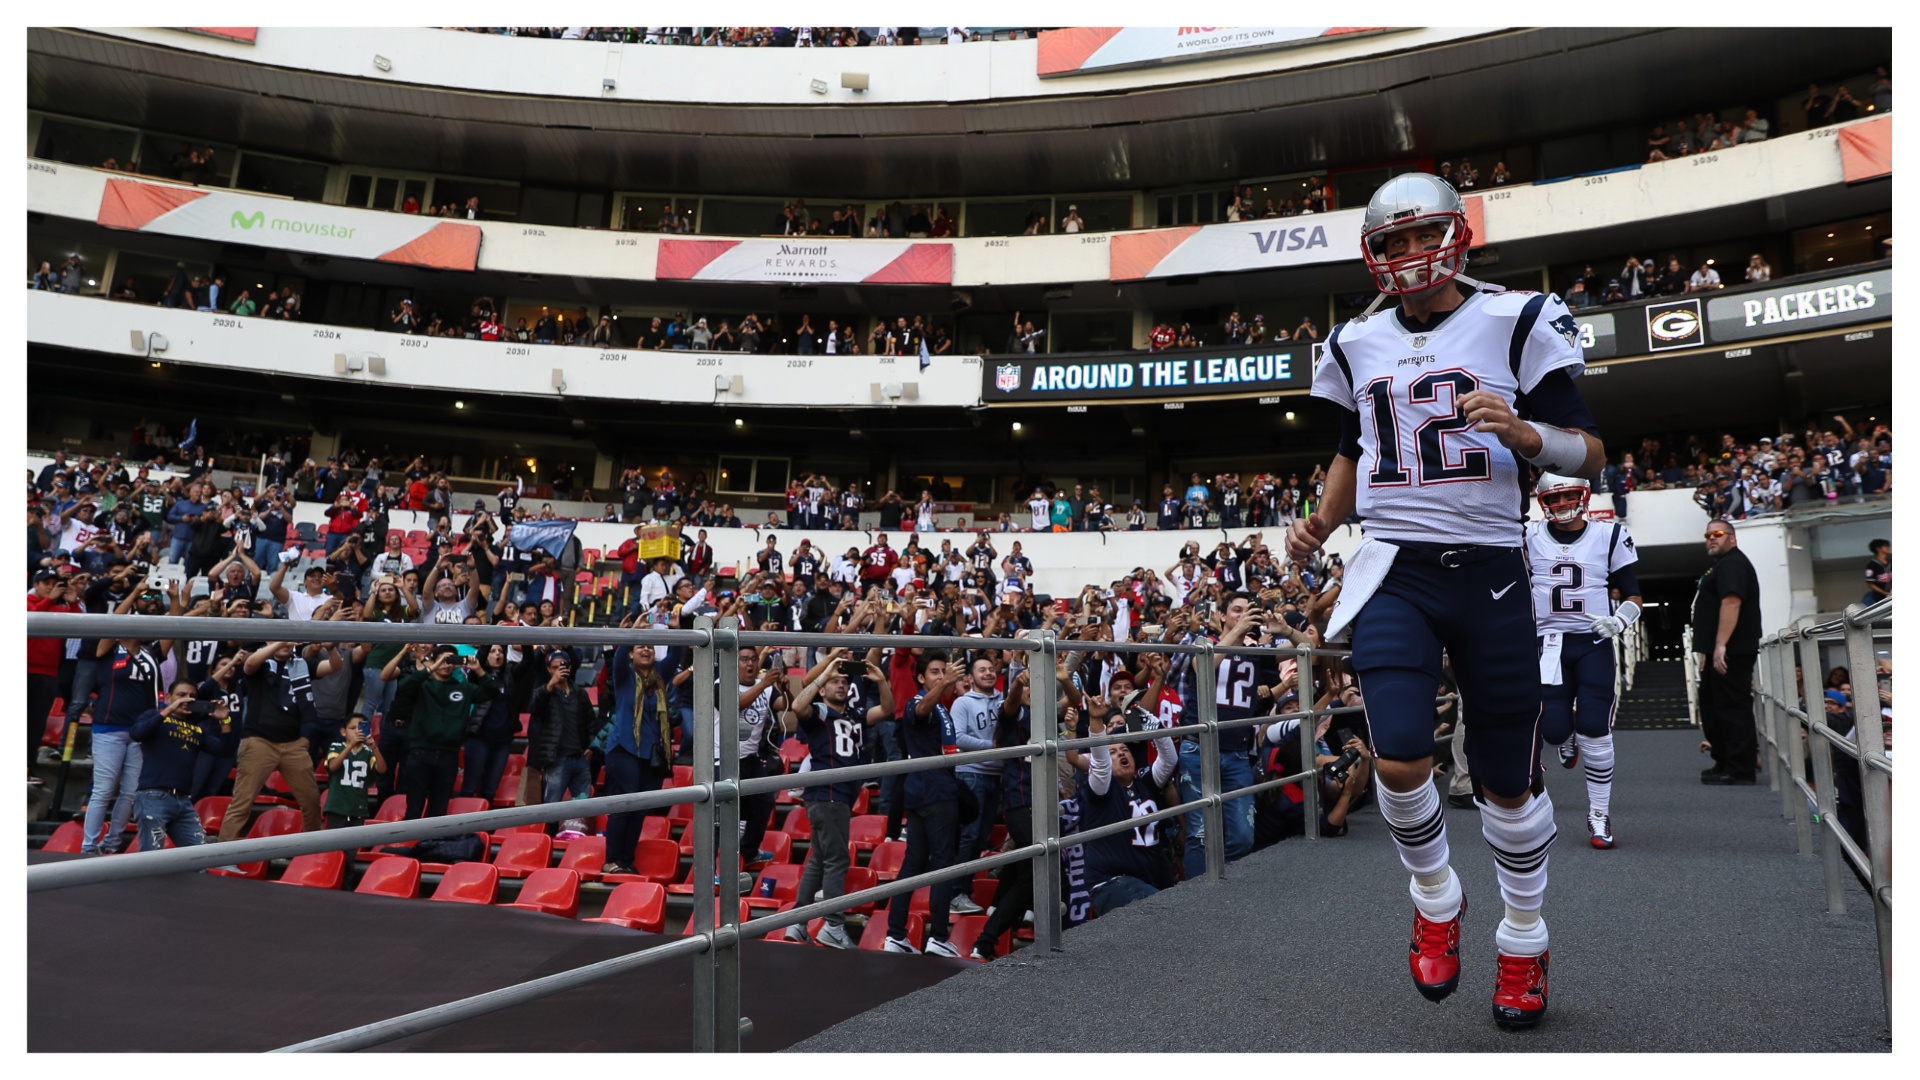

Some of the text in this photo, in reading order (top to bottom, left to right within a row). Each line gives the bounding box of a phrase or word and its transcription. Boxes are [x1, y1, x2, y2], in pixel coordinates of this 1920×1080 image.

[1186, 37, 1218, 47] WORLD
[1220, 35, 1233, 43] OF
[1236, 31, 1249, 40] ITS
[1252, 29, 1275, 38] OWN
[1692, 155, 1719, 167] 3030
[1585, 176, 1608, 187] 3031
[1487, 191, 1511, 201] 3032
[270, 218, 356, 239] movistar
[1248, 225, 1328, 254] VISA
[776, 244, 828, 255] Marriott
[1743, 281, 1876, 327] PACKERS
[213, 318, 235, 328] 2030
[313, 329, 334, 339] 2030
[902, 332, 909, 345] 7
[400, 339, 429, 348] 2030 J
[506, 347, 525, 355] 2030
[600, 353, 627, 362] 2030 H
[697, 358, 716, 366] 2030
[787, 360, 806, 368] 2030
[1397, 354, 1436, 368] PATRIOTS
[1031, 353, 1292, 391] AROUND THE LEAGUE
[1365, 367, 1492, 488] 12
[1826, 450, 1844, 466] 12
[143, 498, 163, 513] 52
[502, 498, 513, 508] 12
[1032, 504, 1045, 516] 87
[1192, 515, 1203, 527] 12
[501, 547, 513, 561] 11
[768, 558, 779, 573] 12
[800, 562, 811, 575] 12
[1550, 561, 1585, 614] 2
[185, 640, 218, 665] 87
[1215, 658, 1254, 709] 12
[975, 709, 997, 731] GA
[833, 719, 862, 759] 87
[338, 759, 367, 789] 12
